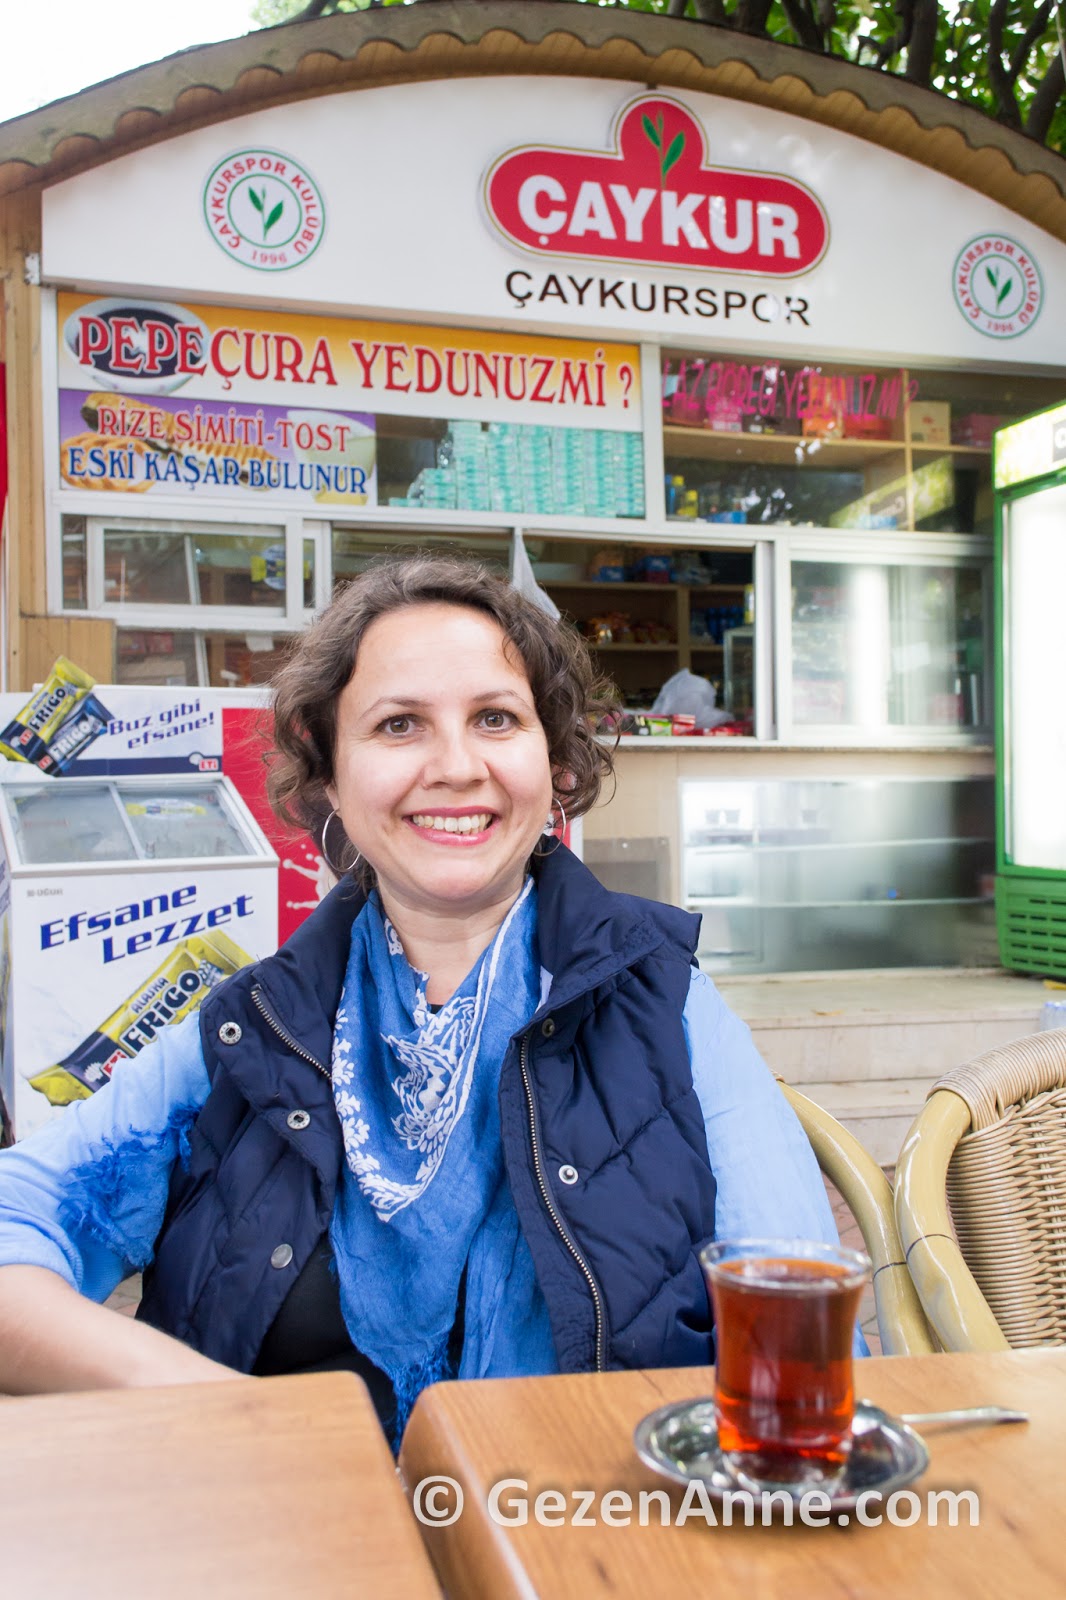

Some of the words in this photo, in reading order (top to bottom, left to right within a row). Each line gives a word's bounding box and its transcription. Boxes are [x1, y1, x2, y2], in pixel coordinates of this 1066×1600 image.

[518, 175, 801, 258] ÇAYKUR
[252, 250, 287, 264] 1996
[352, 342, 606, 407] YEDUNUZMİ
[98, 402, 165, 438] RİZE
[69, 444, 134, 479] ESKİ
[145, 453, 240, 490] KAŞAR
[249, 458, 366, 494] BULUNUR
[110, 716, 152, 735] Buz
[159, 698, 200, 726] gibi
[128, 712, 214, 749] efsane!
[40, 885, 197, 950] Efsane
[103, 894, 254, 964] Lezzet
